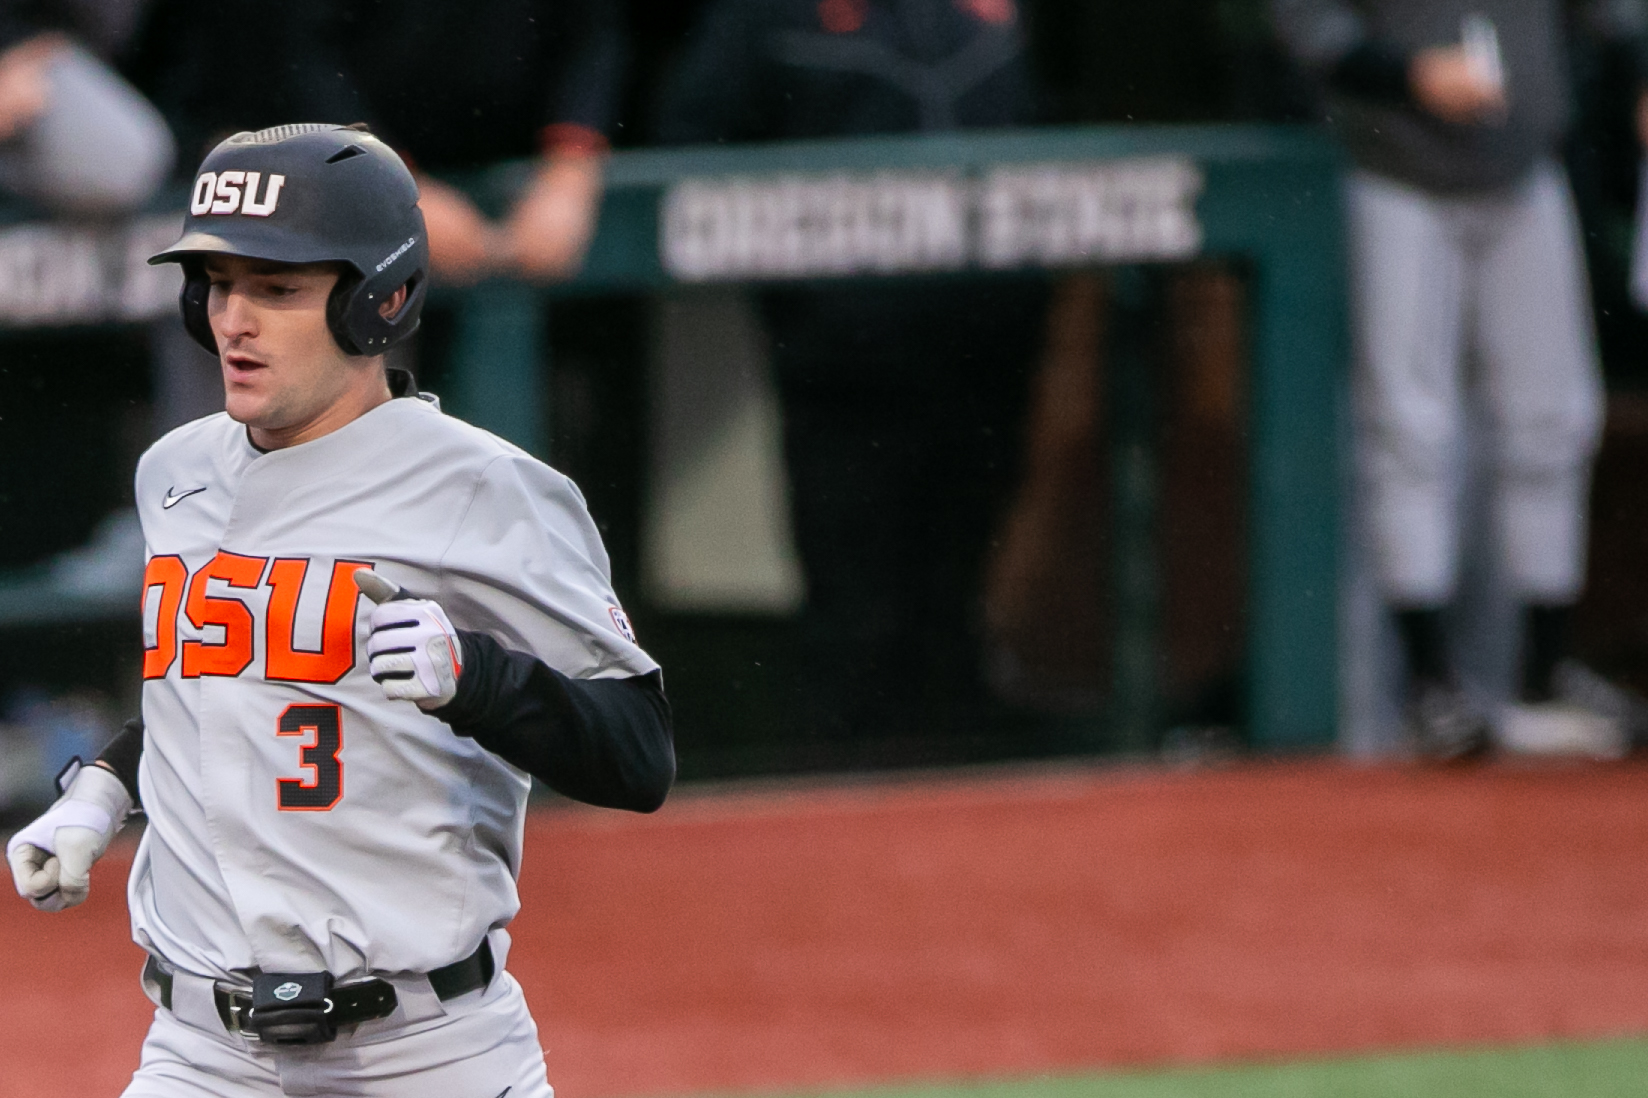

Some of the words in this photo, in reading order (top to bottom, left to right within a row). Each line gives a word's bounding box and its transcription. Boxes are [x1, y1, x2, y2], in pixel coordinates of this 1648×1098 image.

[190, 170, 286, 217] OSU
[141, 549, 375, 686] OSU
[275, 702, 344, 811] 3
